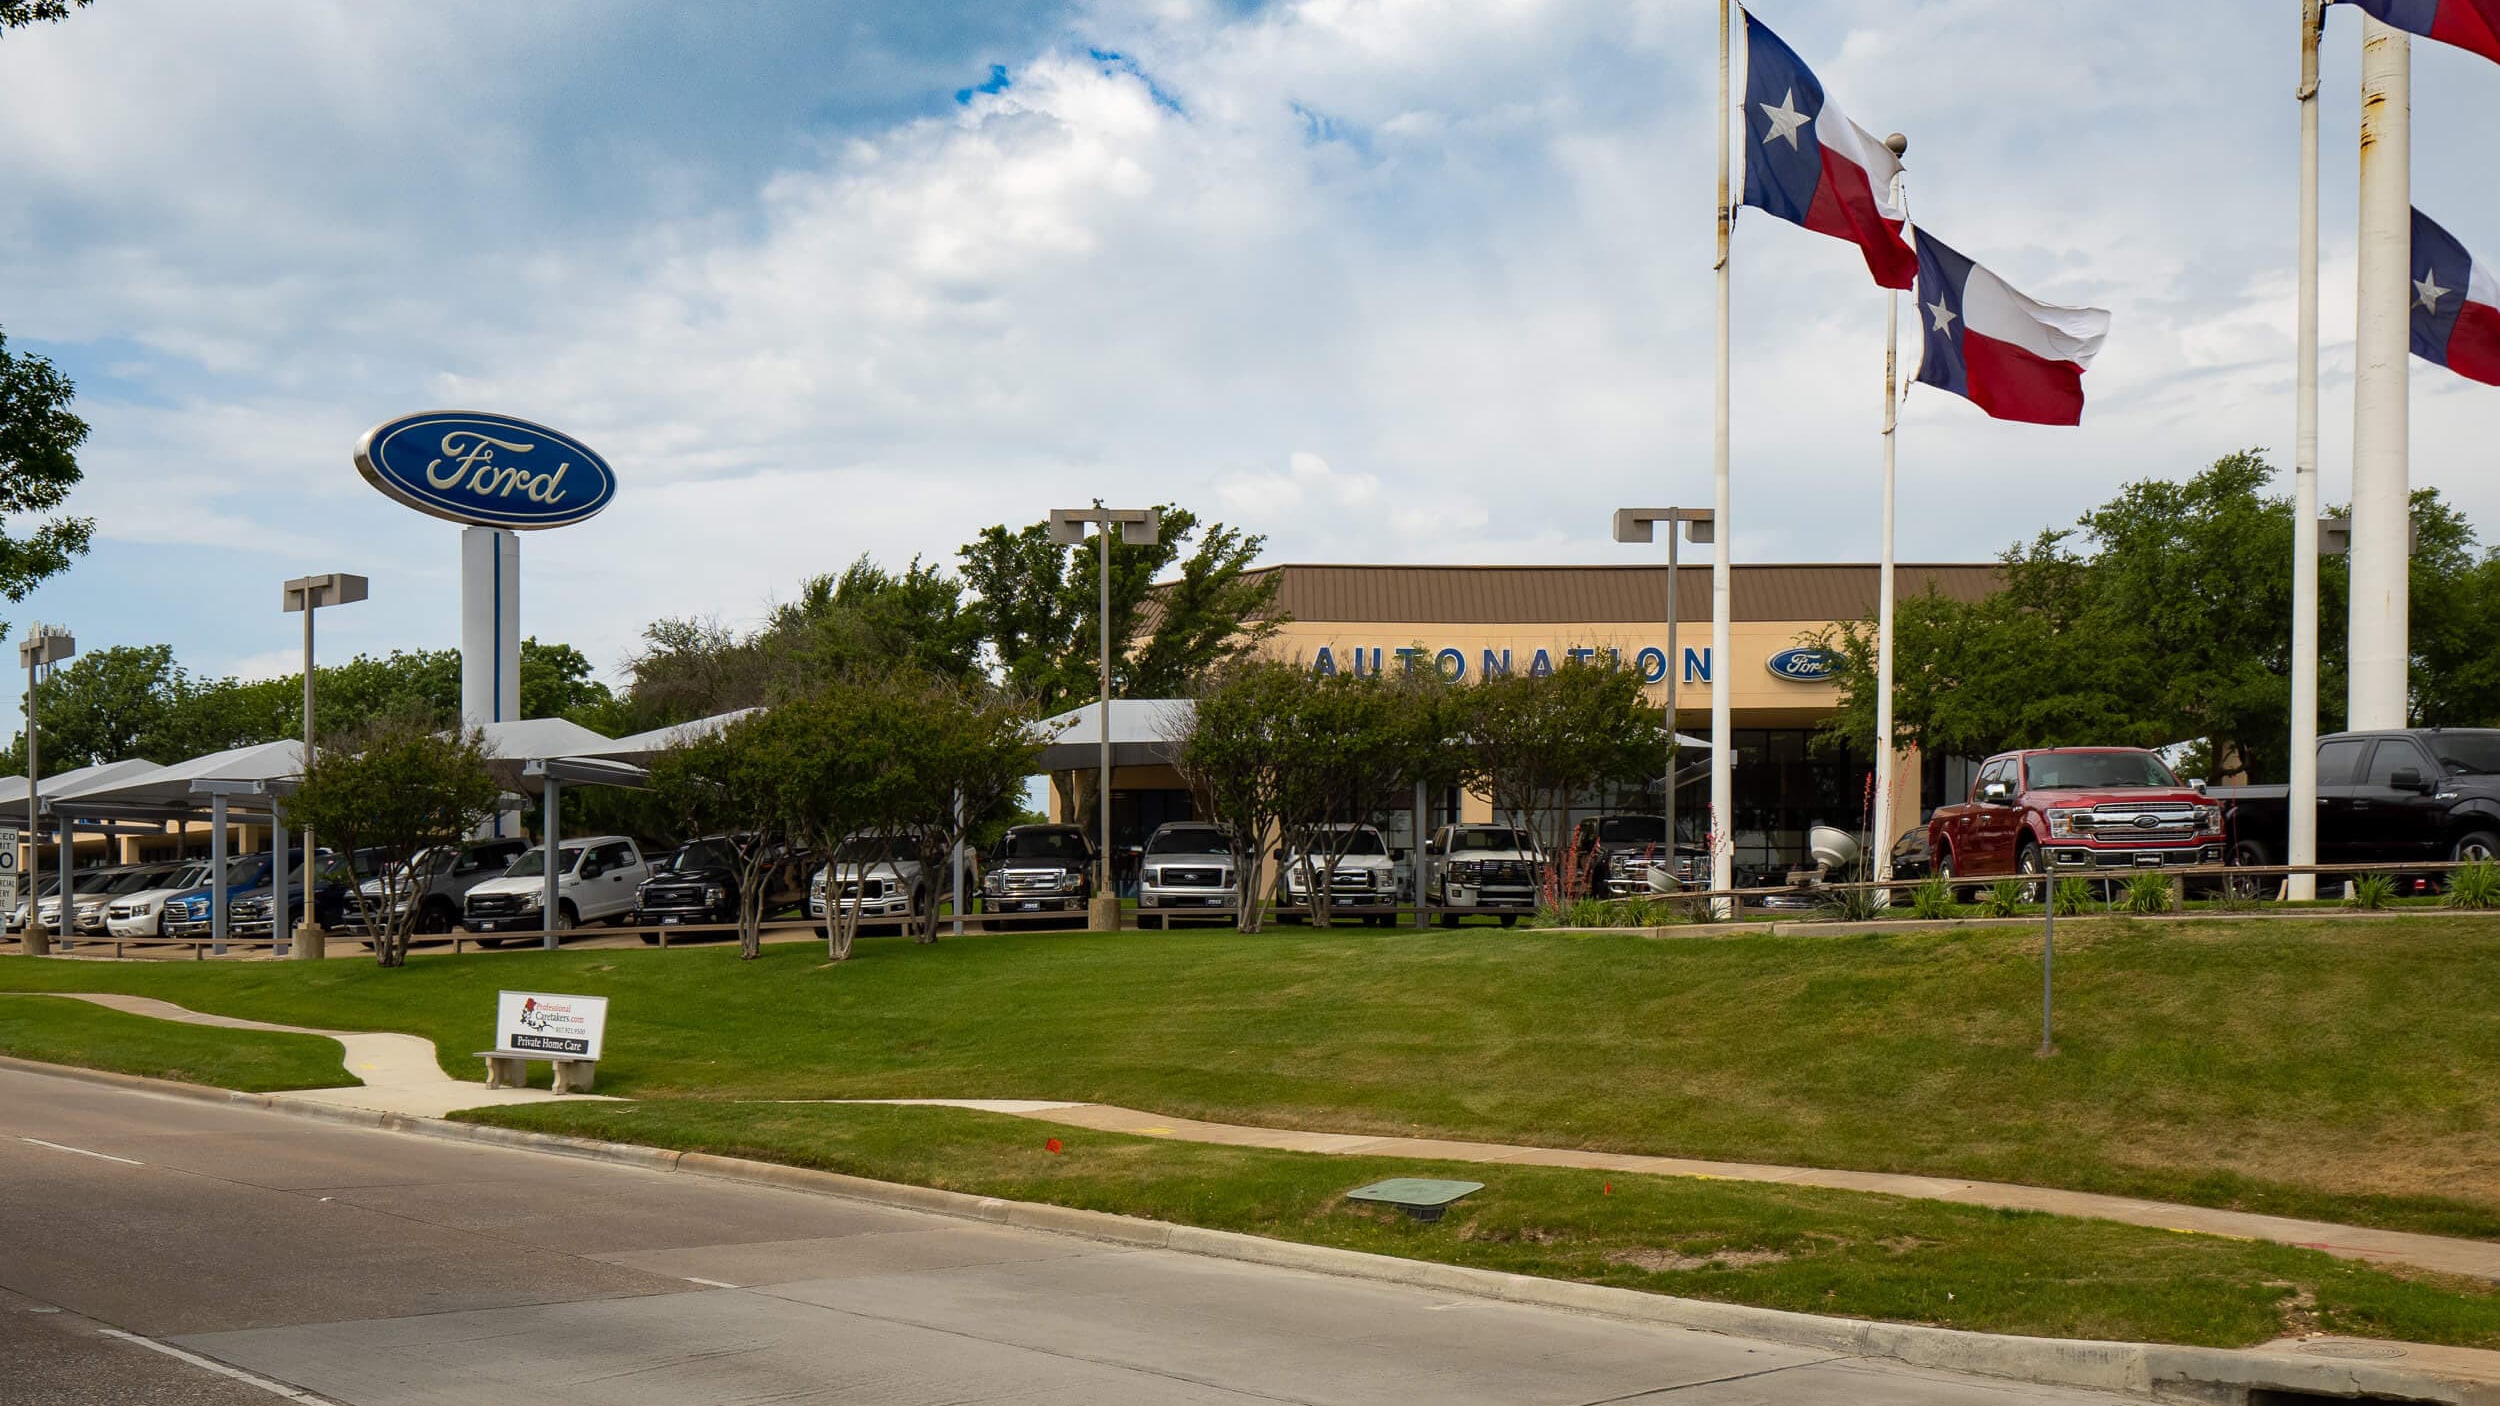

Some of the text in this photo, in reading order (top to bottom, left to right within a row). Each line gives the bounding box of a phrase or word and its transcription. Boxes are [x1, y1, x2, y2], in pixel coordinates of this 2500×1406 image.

[426, 431, 570, 504] Ford
[1307, 645, 1713, 685] AUTONATION
[536, 1002, 571, 1012] Professional
[517, 1036, 582, 1051] Private Home Care
